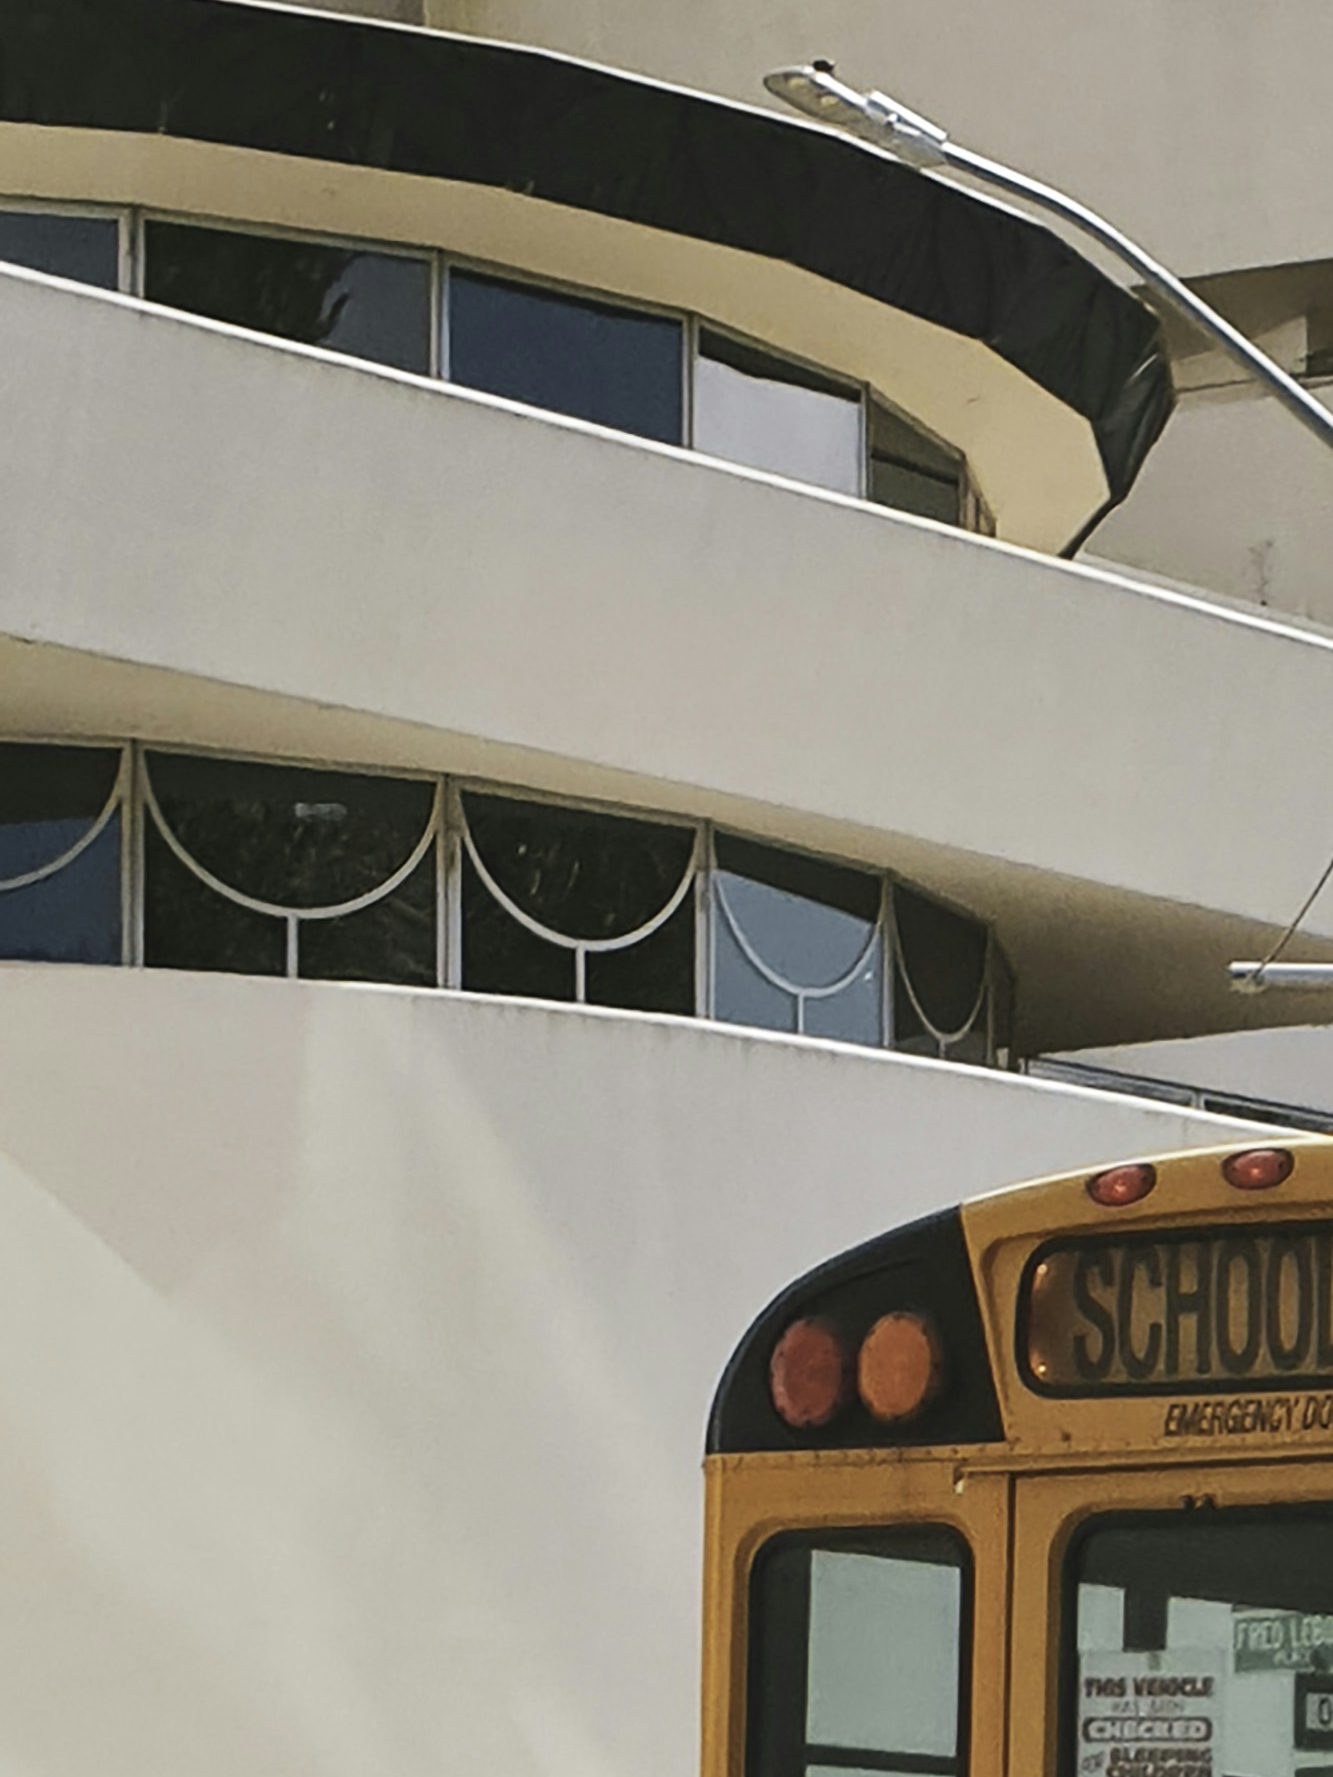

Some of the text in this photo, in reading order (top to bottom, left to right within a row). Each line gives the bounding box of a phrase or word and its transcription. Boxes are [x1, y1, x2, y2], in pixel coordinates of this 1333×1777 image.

[1164, 1397, 1298, 1436] EMERGENCY
[1084, 1675, 1215, 1698] THIS VEHICLE
[1088, 1719, 1208, 1740] CHECKED
